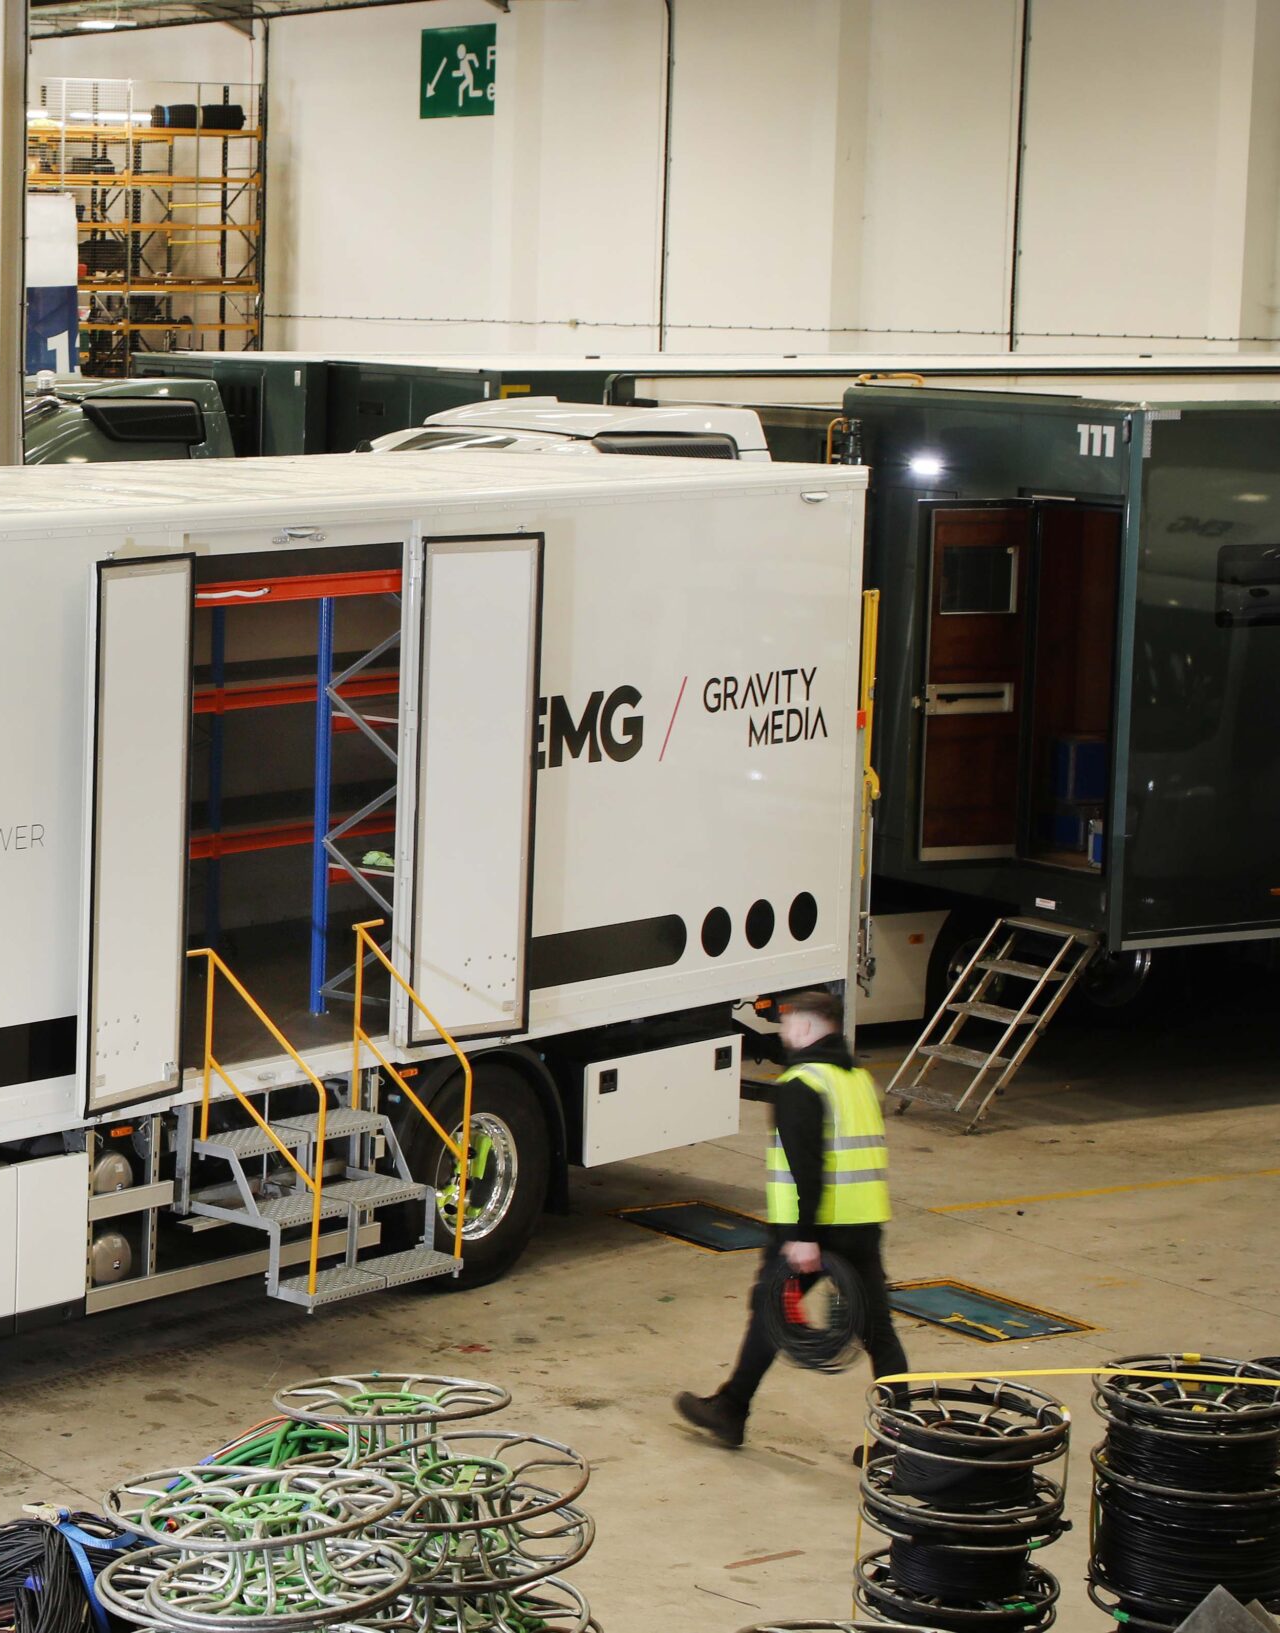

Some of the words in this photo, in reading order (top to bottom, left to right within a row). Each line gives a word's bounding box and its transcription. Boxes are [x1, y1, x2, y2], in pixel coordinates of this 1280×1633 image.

[1077, 423, 1115, 458] 111
[703, 667, 818, 713] GRAVITY
[748, 706, 828, 748] MEDIA
